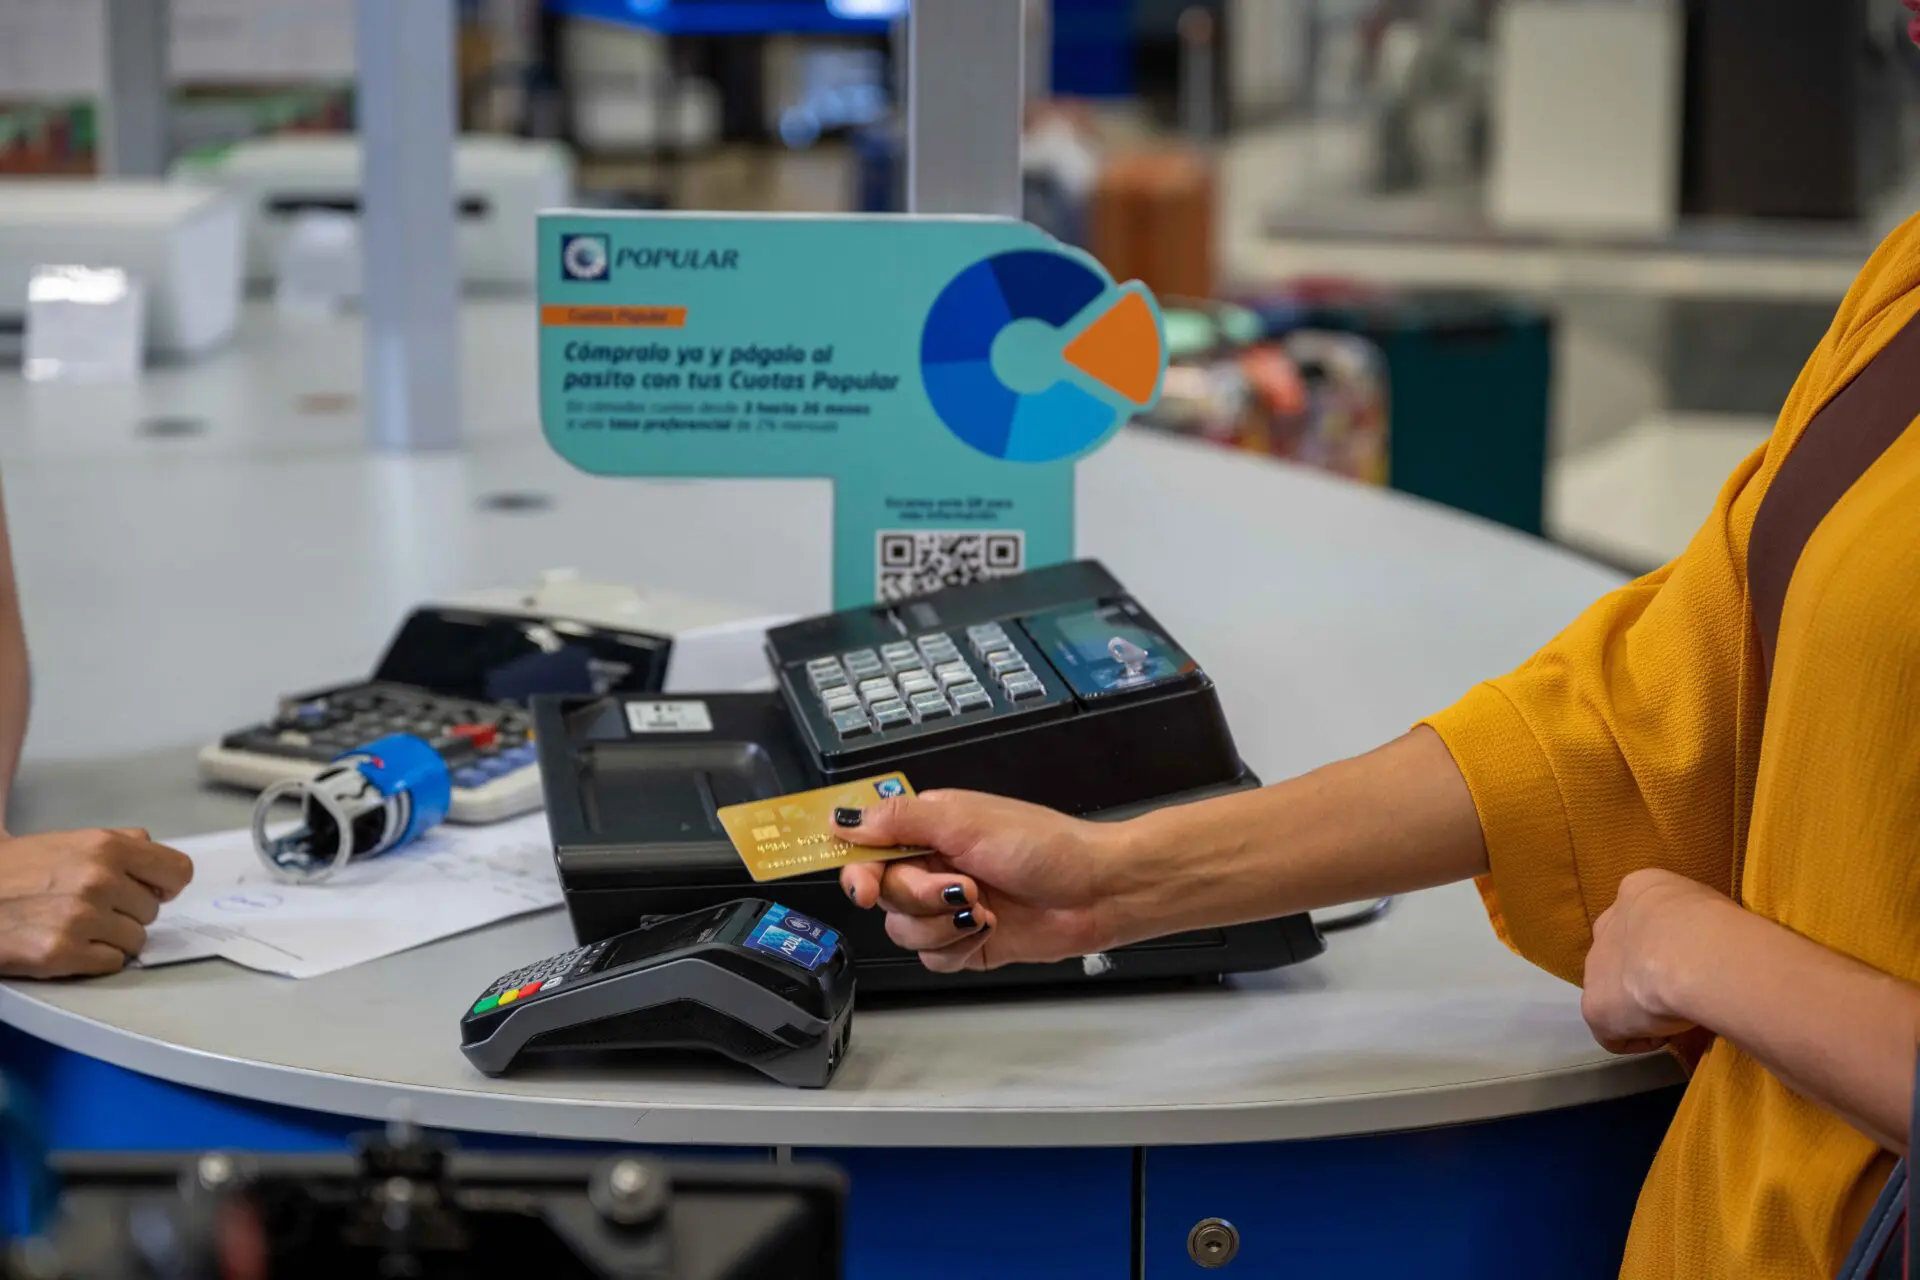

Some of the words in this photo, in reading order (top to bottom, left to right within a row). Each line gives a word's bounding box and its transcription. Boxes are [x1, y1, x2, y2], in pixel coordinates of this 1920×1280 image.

[615, 247, 740, 270] POPULAR
[563, 341, 672, 364] Cómpralo
[675, 346, 704, 366] ya
[708, 347, 724, 367] y
[728, 344, 806, 367] págalo
[811, 344, 835, 364] al
[563, 369, 637, 393] pasito
[641, 373, 682, 390] con
[688, 372, 723, 390] tus
[729, 370, 805, 391] Cuotas
[812, 370, 900, 394] Popular
[780, 936, 803, 955] AZUL
